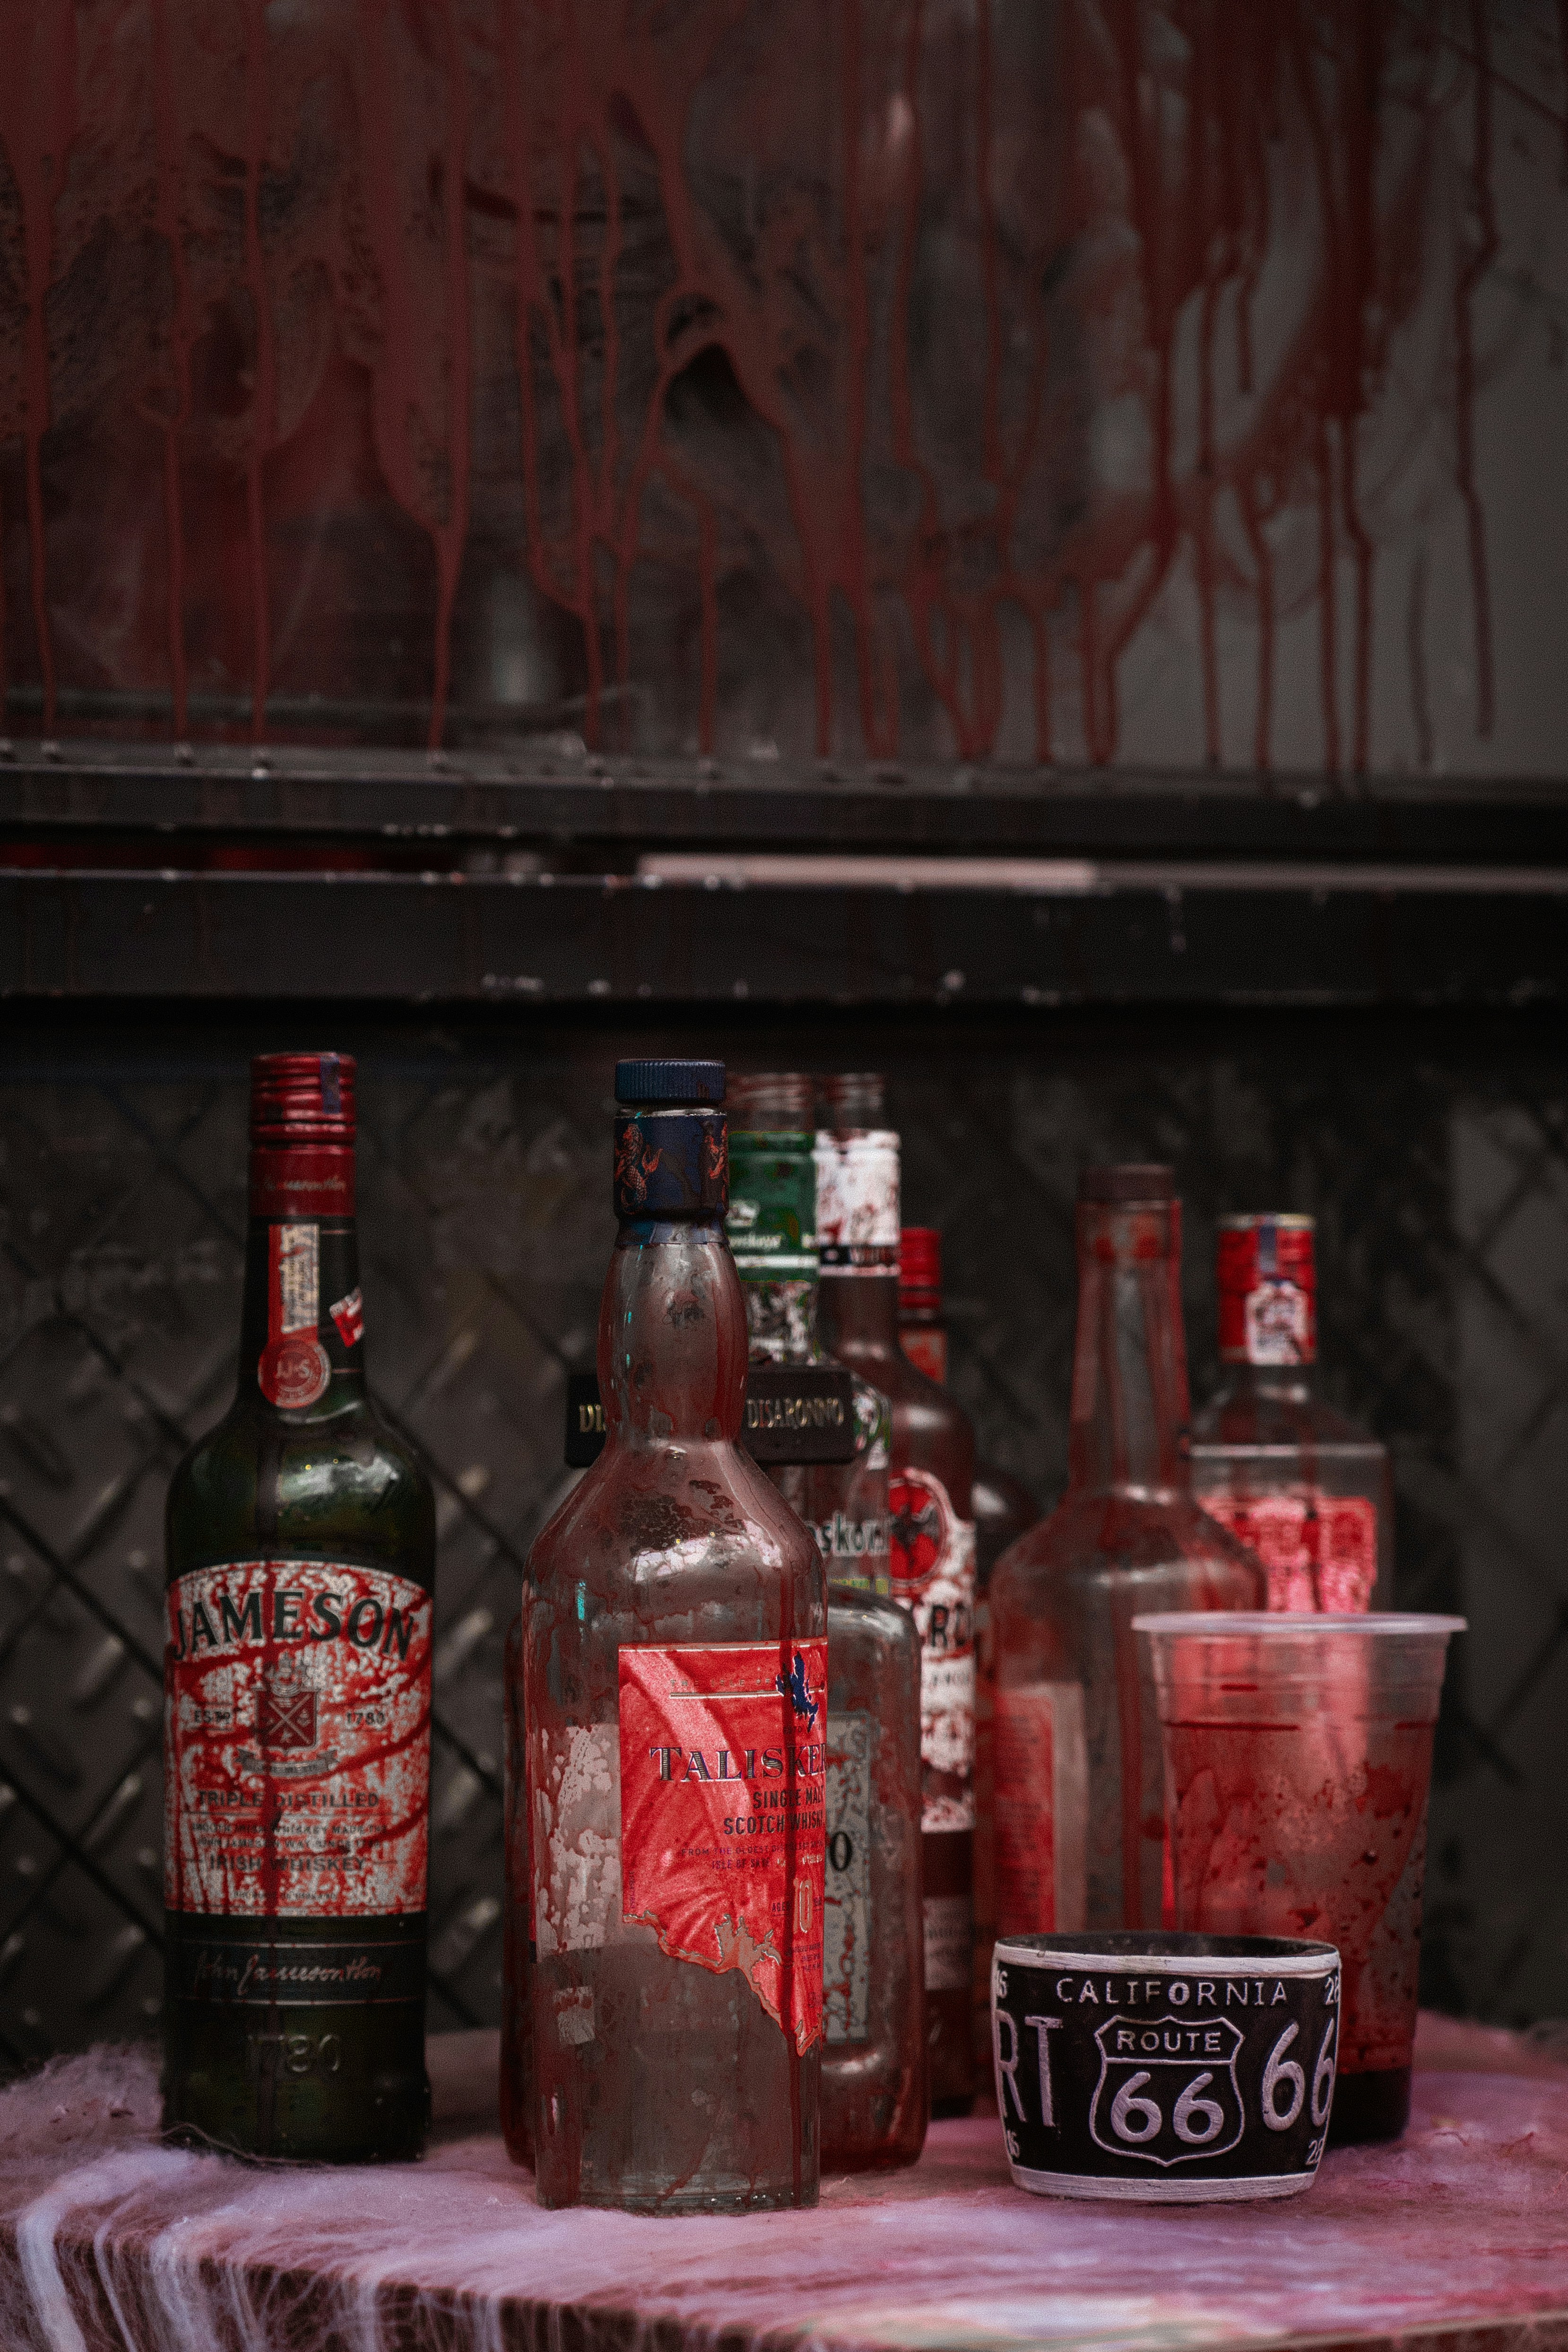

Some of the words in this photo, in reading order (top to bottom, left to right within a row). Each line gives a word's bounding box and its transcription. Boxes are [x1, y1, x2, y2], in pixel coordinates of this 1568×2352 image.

[174, 1590, 414, 1661] JAMESON
[199, 1790, 264, 1808] TRIPLE
[273, 1792, 379, 1808] DISTILLED
[753, 1789, 801, 1809] SINGLE
[724, 1815, 785, 1835] SCOTCH
[682, 1848, 709, 1856] FROM
[209, 1855, 262, 1871] IRISH
[712, 1859, 732, 1869] ISLE
[1056, 1978, 1288, 2006] CALIFORNIA
[1117, 2031, 1221, 2053] ROUTE
[1111, 2072, 1224, 2144] 66
